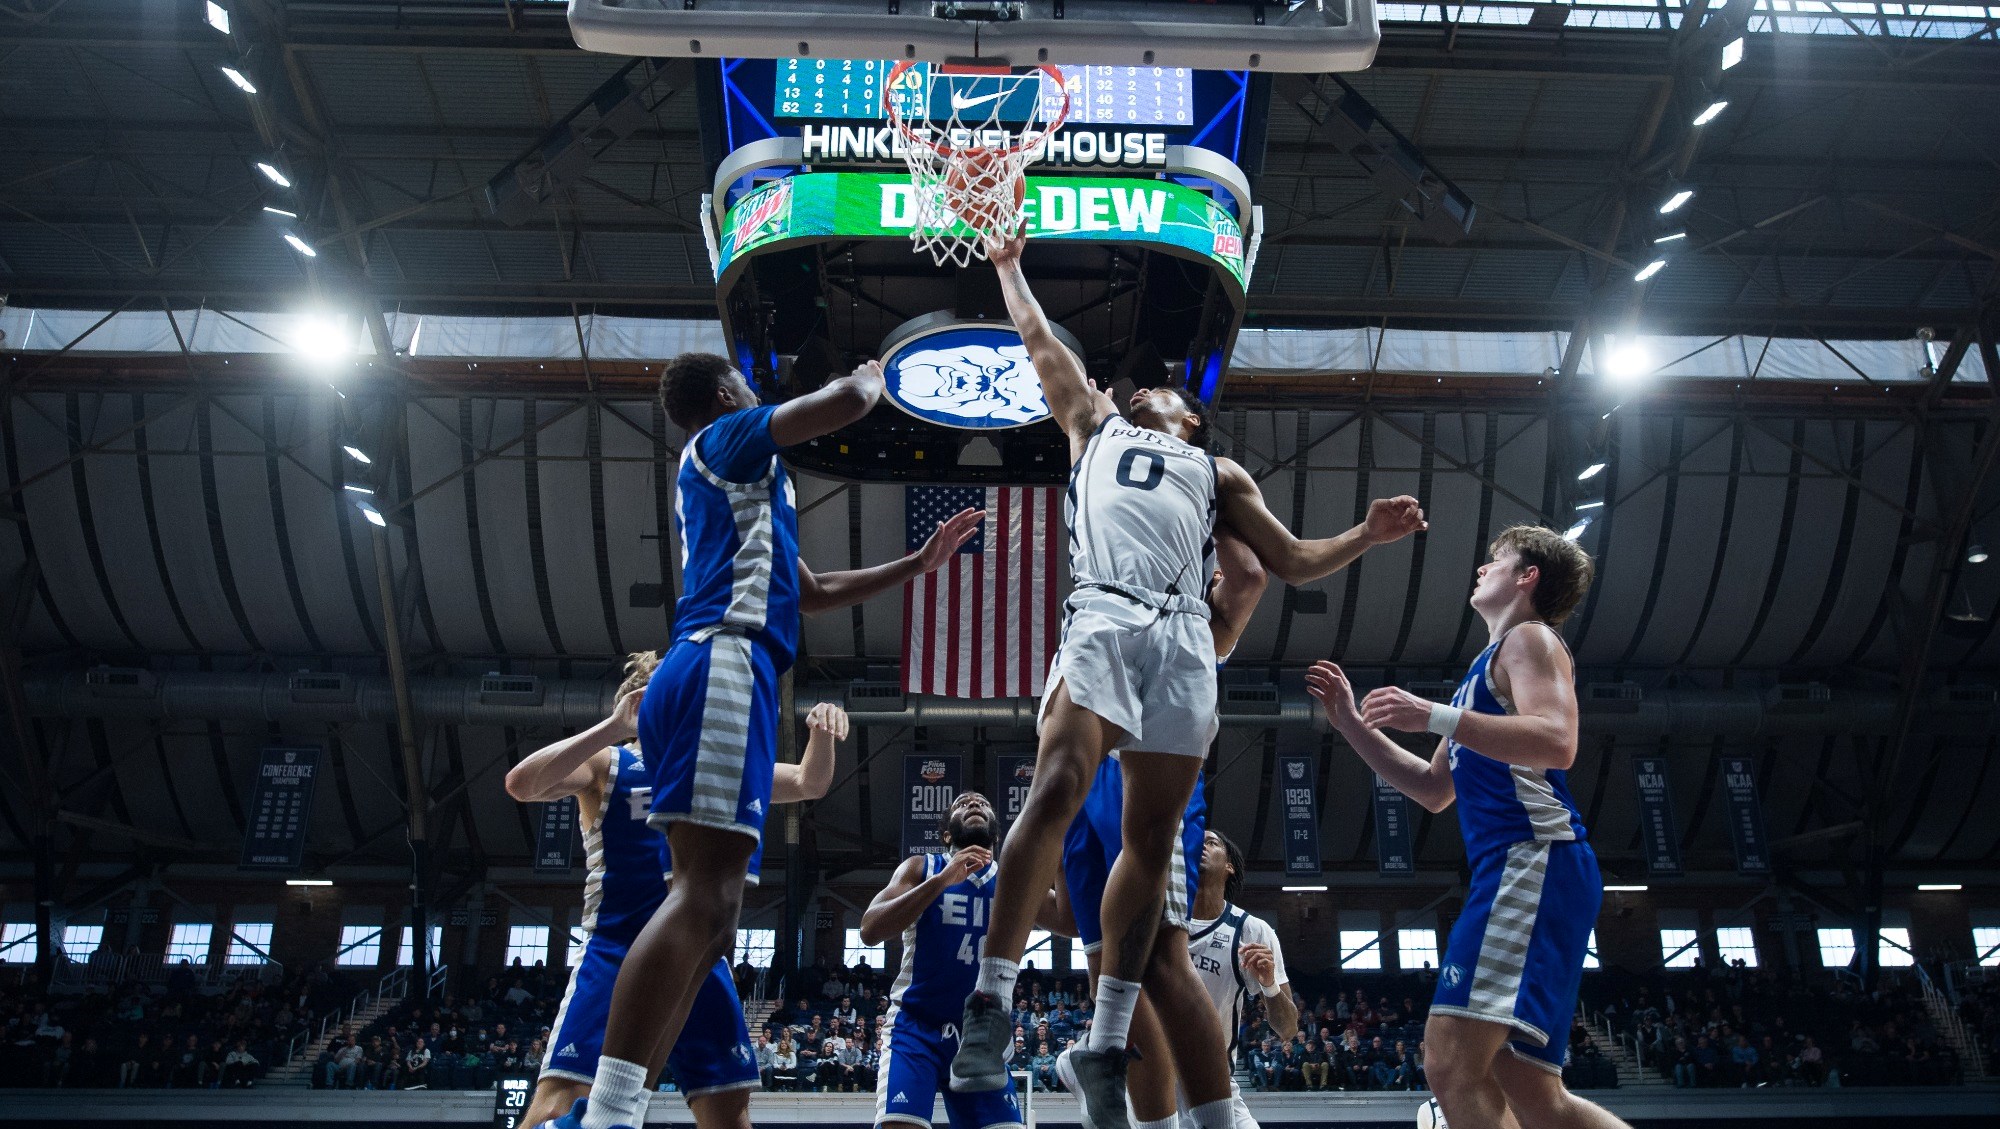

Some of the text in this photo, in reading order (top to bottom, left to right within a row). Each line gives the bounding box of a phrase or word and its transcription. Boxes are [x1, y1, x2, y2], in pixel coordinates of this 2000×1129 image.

[789, 59, 874, 71] 2 0 2 0
[1097, 65, 1184, 77] 13 3 0 0
[788, 73, 874, 85] 4 6 4 0
[890, 72, 922, 90] 20
[1050, 74, 1083, 93] 14
[1097, 80, 1183, 92] 32 2 1 1
[784, 88, 873, 99] 13 4 1 0
[1096, 95, 1183, 106] 40 2 1 1
[782, 102, 871, 114] 52 2 1 1
[1074, 97, 1083, 107] 4
[1096, 109, 1185, 121] 55 0 3 0
[803, 125, 1167, 164] HINKLE FIELDHOUSE
[878, 183, 957, 228] DO
[1109, 428, 1194, 457] BUTL
[1116, 448, 1165, 491] 0
[262, 764, 314, 778] CONFERENCE
[1638, 774, 1665, 788] NCAA
[1726, 774, 1753, 788] NCAA
[911, 785, 953, 812] 2010
[1008, 786, 1031, 813] 20
[1285, 788, 1312, 805] 1929
[924, 830, 939, 840] 33-5
[1293, 829, 1308, 840] 17-2
[925, 845, 948, 854] BASKETBA
[938, 893, 993, 927] EI
[816, 919, 833, 929] 224
[1189, 952, 1221, 977] LER
[505, 1091, 526, 1107] 20
[506, 1116, 515, 1129] 3
